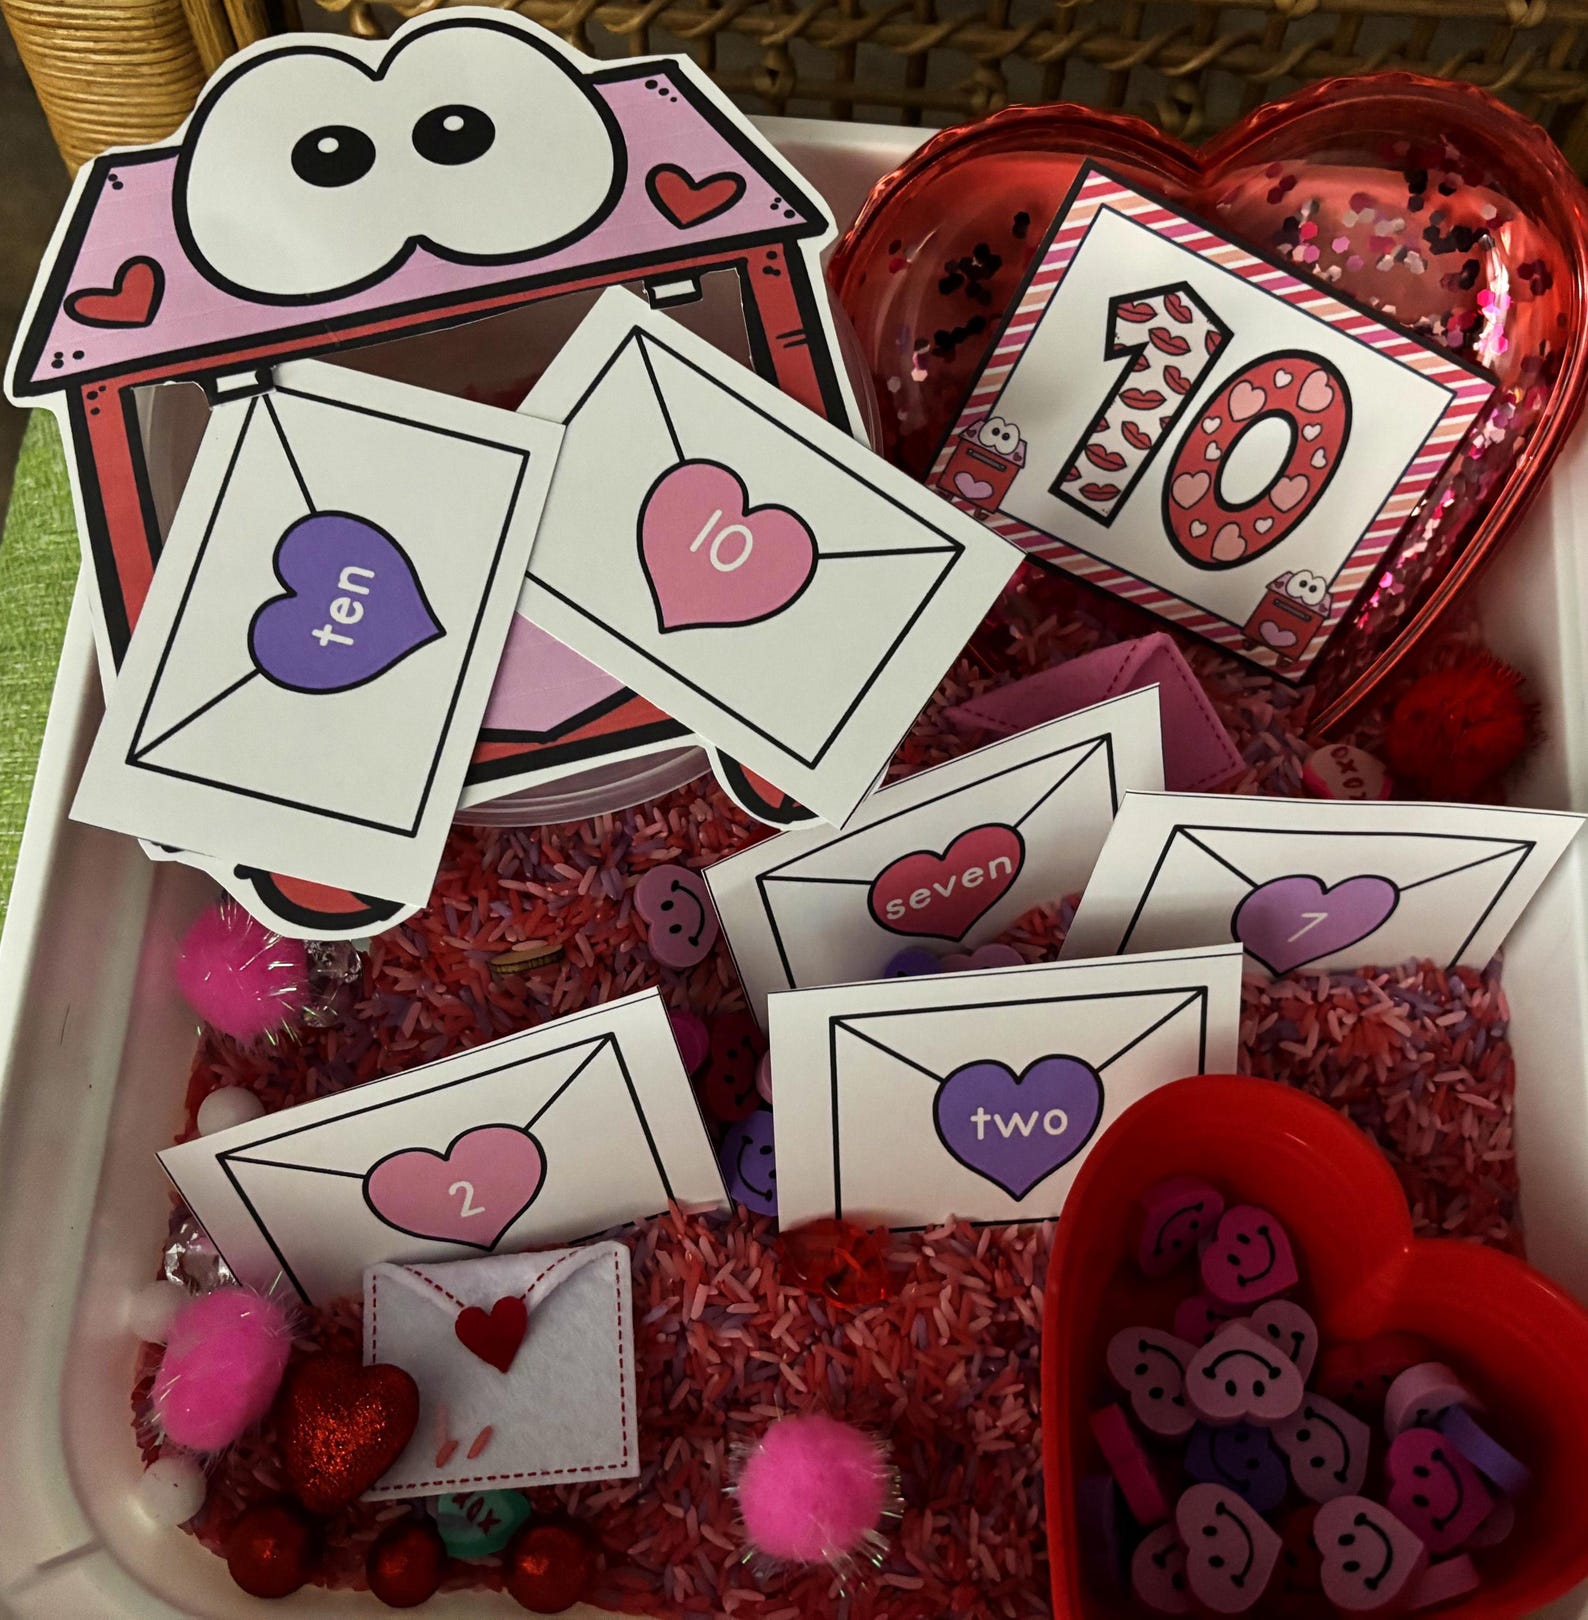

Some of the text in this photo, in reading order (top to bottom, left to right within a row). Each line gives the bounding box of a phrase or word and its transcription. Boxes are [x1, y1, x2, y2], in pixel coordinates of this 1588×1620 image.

[1048, 281, 1352, 571] 10
[690, 510, 753, 571] 10
[311, 567, 374, 647] ten
[886, 856, 1012, 920] seven
[1288, 912, 1328, 942] 7
[970, 1107, 1068, 1141] two
[448, 1181, 486, 1218] 2
